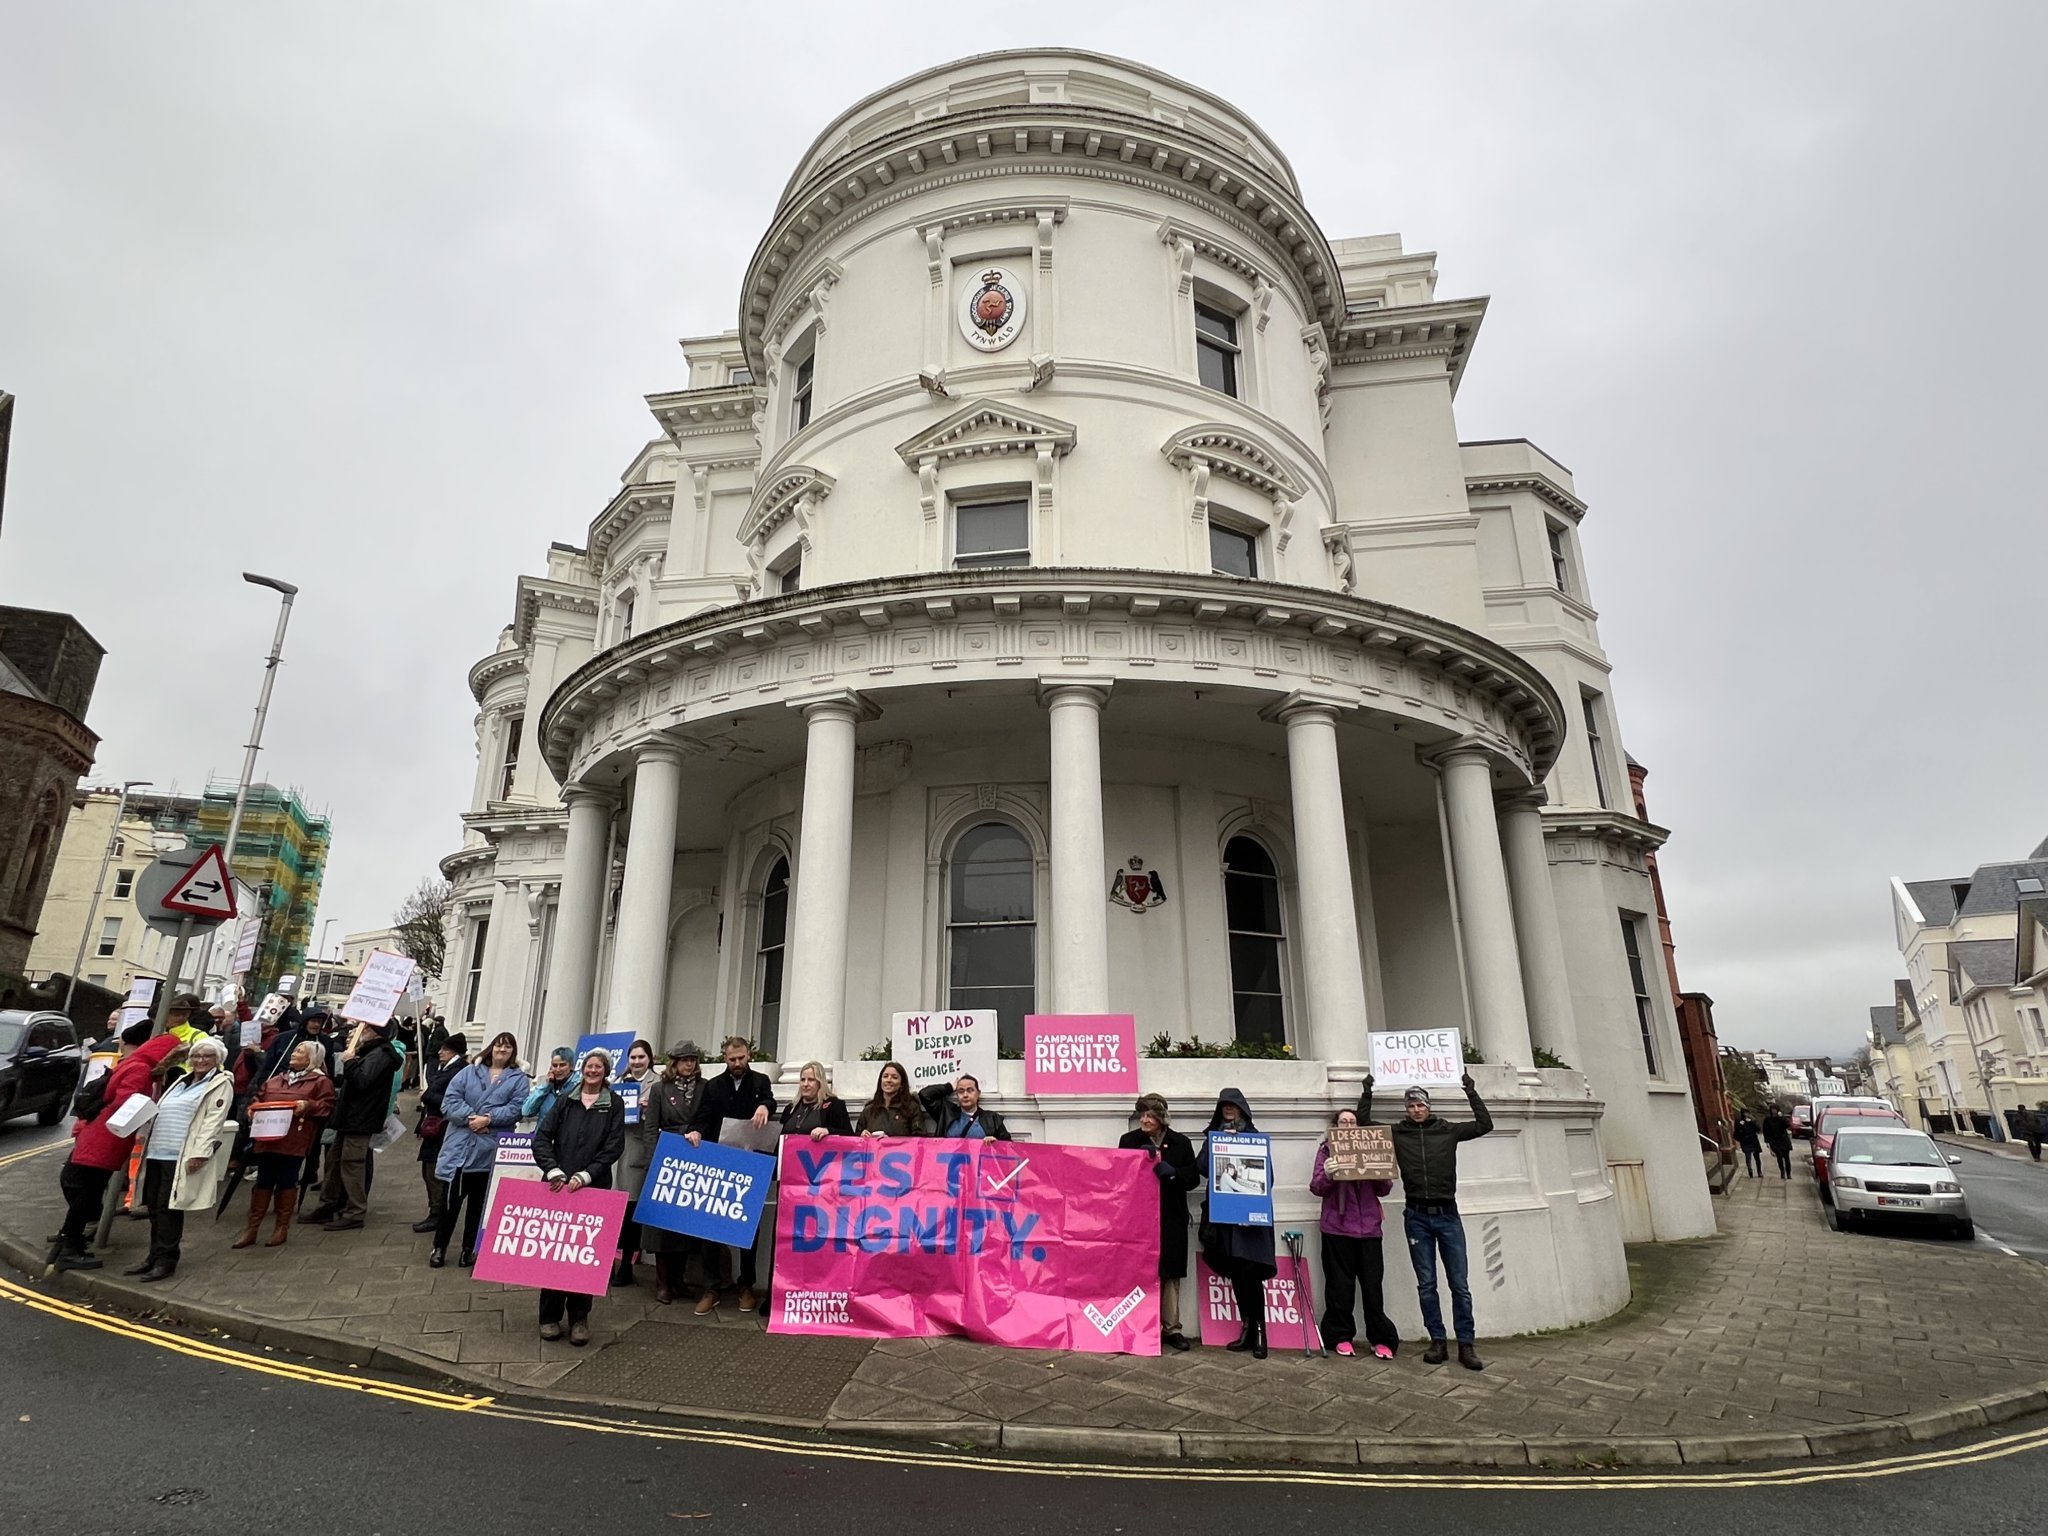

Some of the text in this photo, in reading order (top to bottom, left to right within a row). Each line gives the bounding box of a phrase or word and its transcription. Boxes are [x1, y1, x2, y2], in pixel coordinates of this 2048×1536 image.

[971, 326, 1013, 345] TYNWALD
[907, 1015, 974, 1036] MY DAD
[915, 1034, 972, 1051] DESERVED
[1035, 1034, 1120, 1043] CAMPAIGN FOR
[1385, 1033, 1449, 1049] CHOICE
[610, 1049, 624, 1057] FOR
[933, 1049, 954, 1059] THE
[1035, 1043, 1119, 1058] DIGNITY
[914, 1060, 962, 1078] CHOICE!
[1035, 1058, 1127, 1073] IN DYING.
[1382, 1059, 1409, 1075] NOT
[1416, 1057, 1455, 1073] RULE
[499, 1137, 532, 1146] CAMPA
[1212, 1136, 1250, 1144] CAMPAIGN
[1331, 1130, 1384, 1140] I DESERVE
[1332, 1140, 1393, 1152] THE RIGHT TO
[499, 1150, 533, 1160] Simon
[1362, 1152, 1395, 1163] DIGNITY
[663, 1157, 753, 1186] CAMPAIGN FOR
[797, 1151, 913, 1198] YES
[657, 1166, 750, 1202] DIGNITY
[651, 1184, 748, 1222] IN DYING.
[503, 1204, 604, 1227] CAMPAIGN FOR
[498, 1216, 601, 1245] DIGNITY
[791, 1205, 1046, 1262] DIGNITY.
[492, 1235, 600, 1267] IN DYING.
[1272, 1279, 1296, 1290] FOR
[785, 1291, 848, 1300] CAMPAIGN FOR
[1209, 1286, 1296, 1307] DIITY
[784, 1299, 848, 1311] DIGNITY
[1210, 1304, 1227, 1321] IN
[783, 1312, 854, 1324] IN DYING.
[1088, 1307, 1104, 1326] YES
